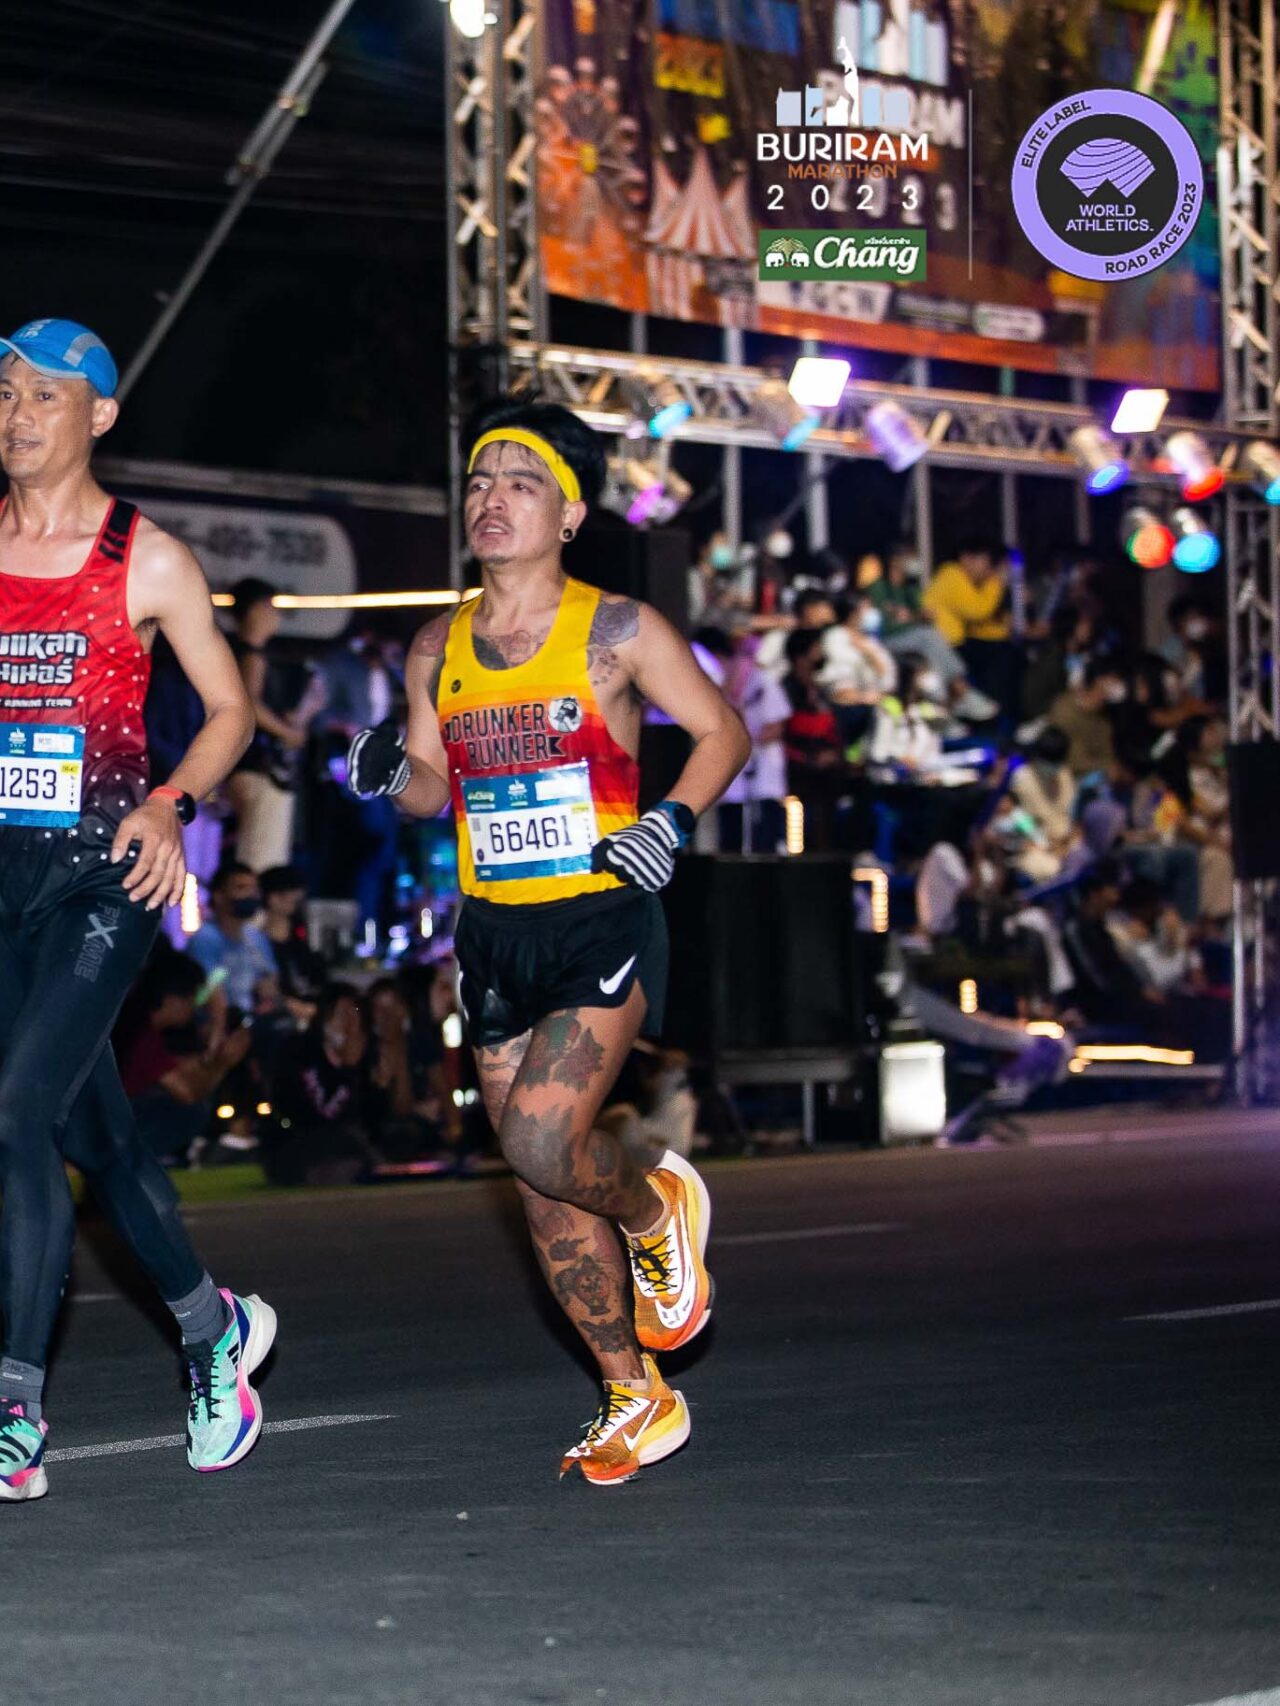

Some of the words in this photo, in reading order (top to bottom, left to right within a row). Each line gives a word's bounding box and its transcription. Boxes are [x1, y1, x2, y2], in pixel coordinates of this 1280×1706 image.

[451, 703, 547, 743] DRUNKER
[467, 733, 549, 769] RUNNER
[489, 815, 572, 854] 66461
